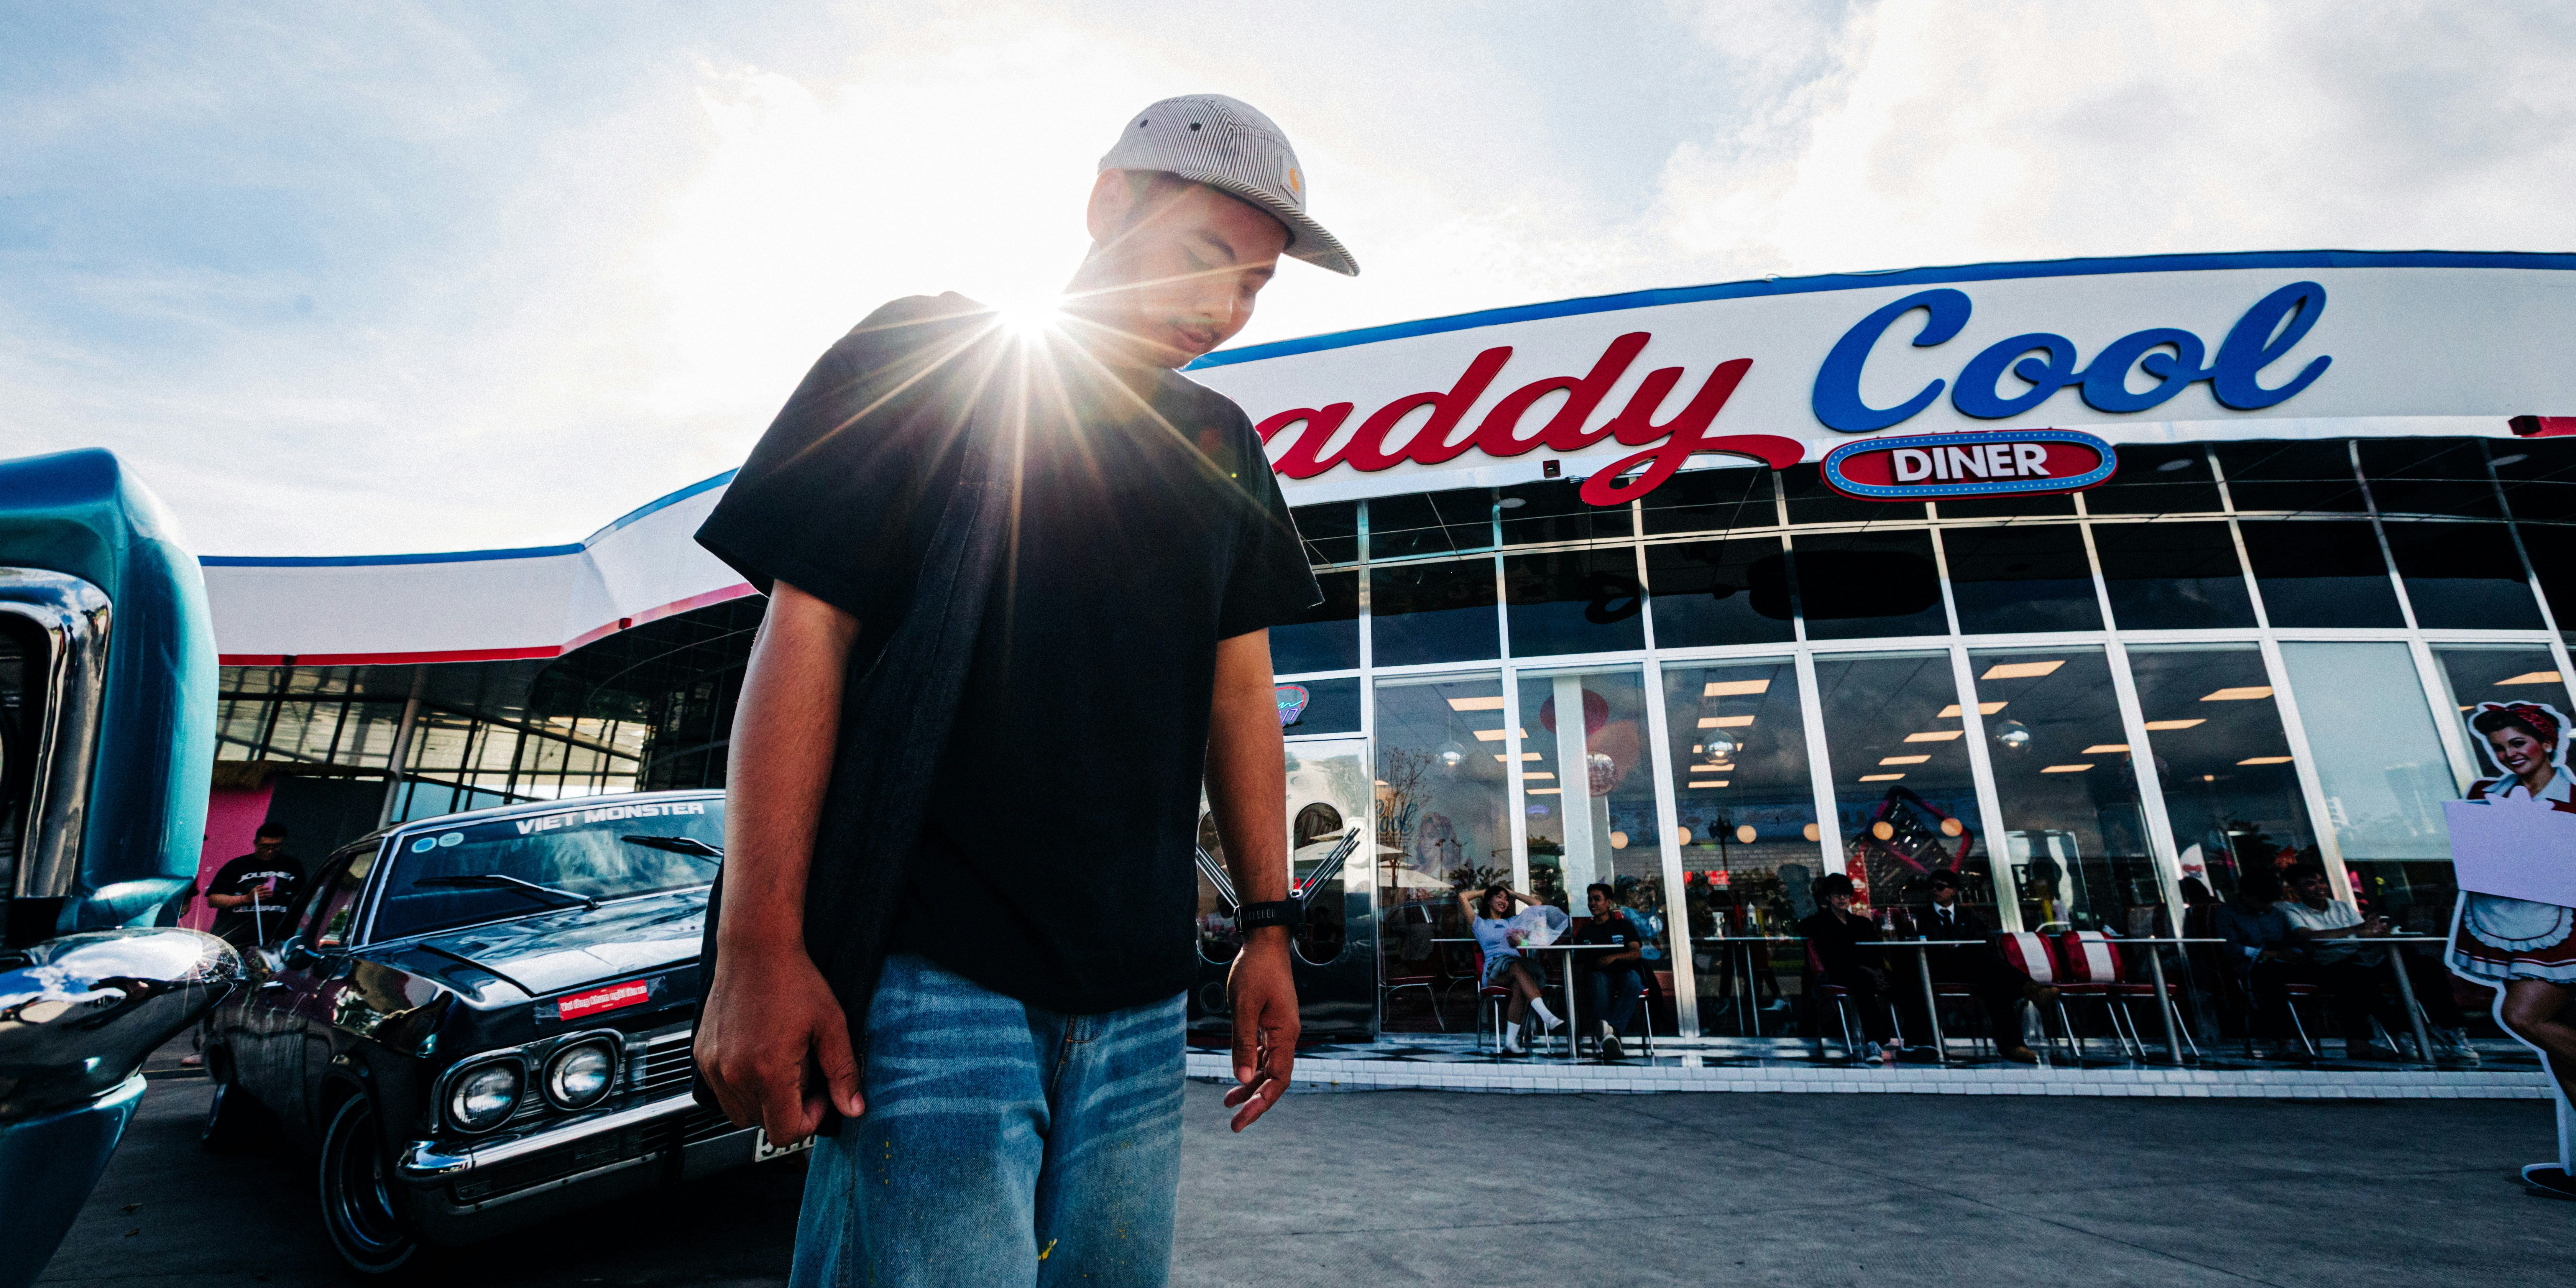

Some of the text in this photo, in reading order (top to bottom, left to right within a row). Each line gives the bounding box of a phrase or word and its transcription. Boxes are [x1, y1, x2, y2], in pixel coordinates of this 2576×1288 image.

[1255, 281, 2333, 507] addy Cool
[1893, 442, 2051, 483] DINER
[516, 803, 705, 835] VIET MONSTER
[560, 1001, 573, 1012] Vui
